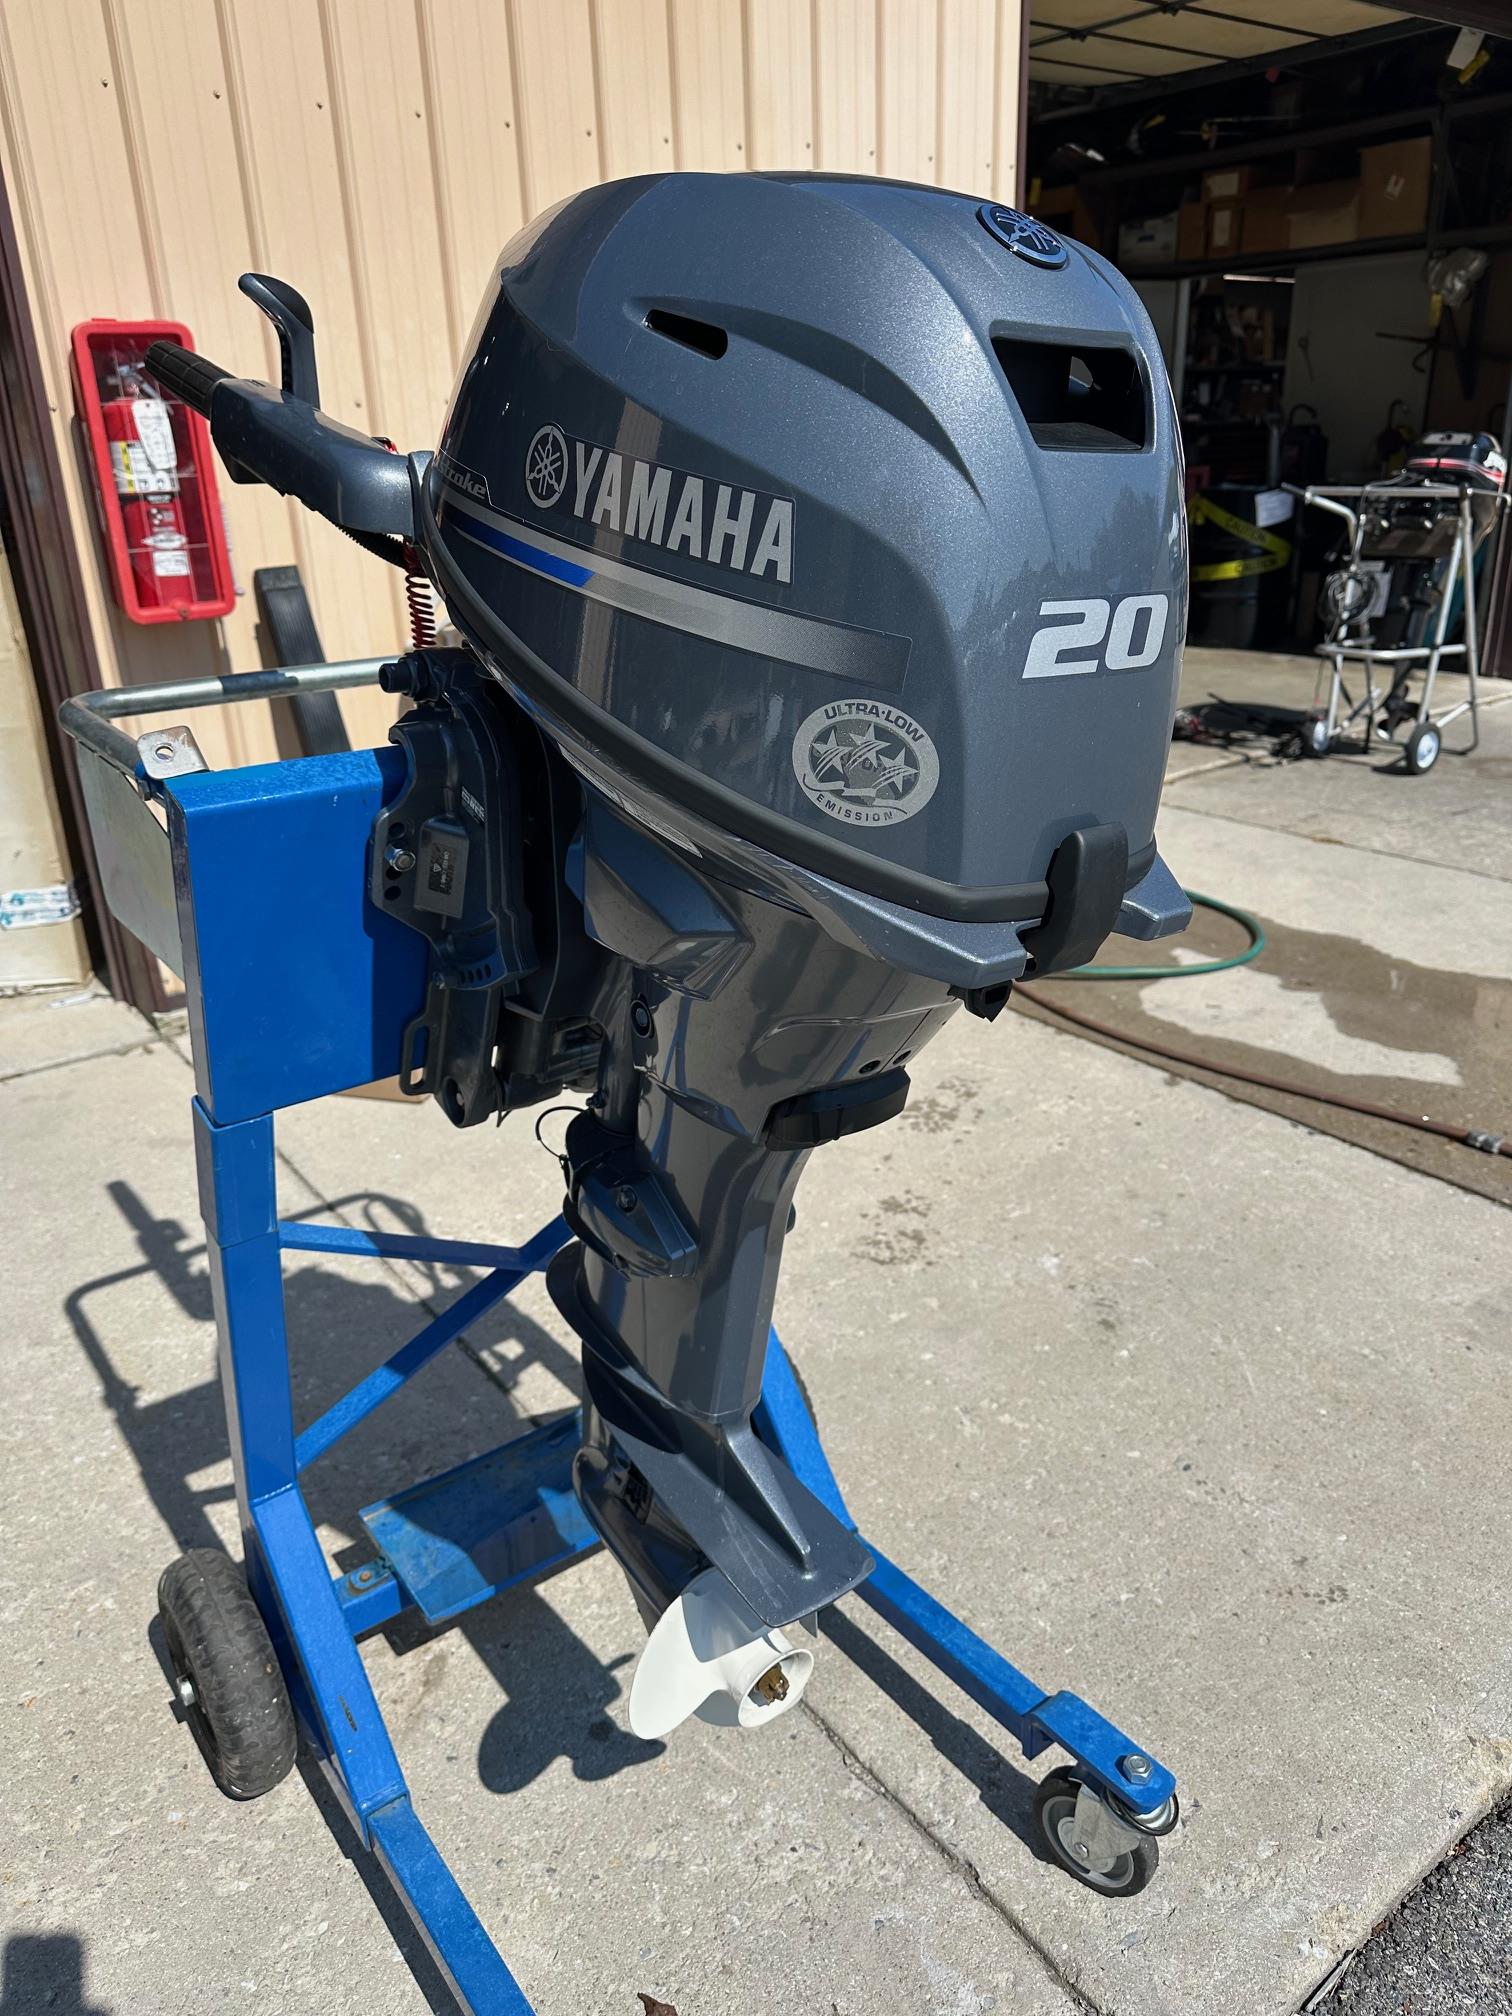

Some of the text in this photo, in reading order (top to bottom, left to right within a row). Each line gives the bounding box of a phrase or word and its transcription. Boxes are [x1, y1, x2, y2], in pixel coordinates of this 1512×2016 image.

[573, 441, 793, 583] YAMAHA
[1022, 594, 1168, 679] 20
[816, 793, 894, 822] EMISSION
